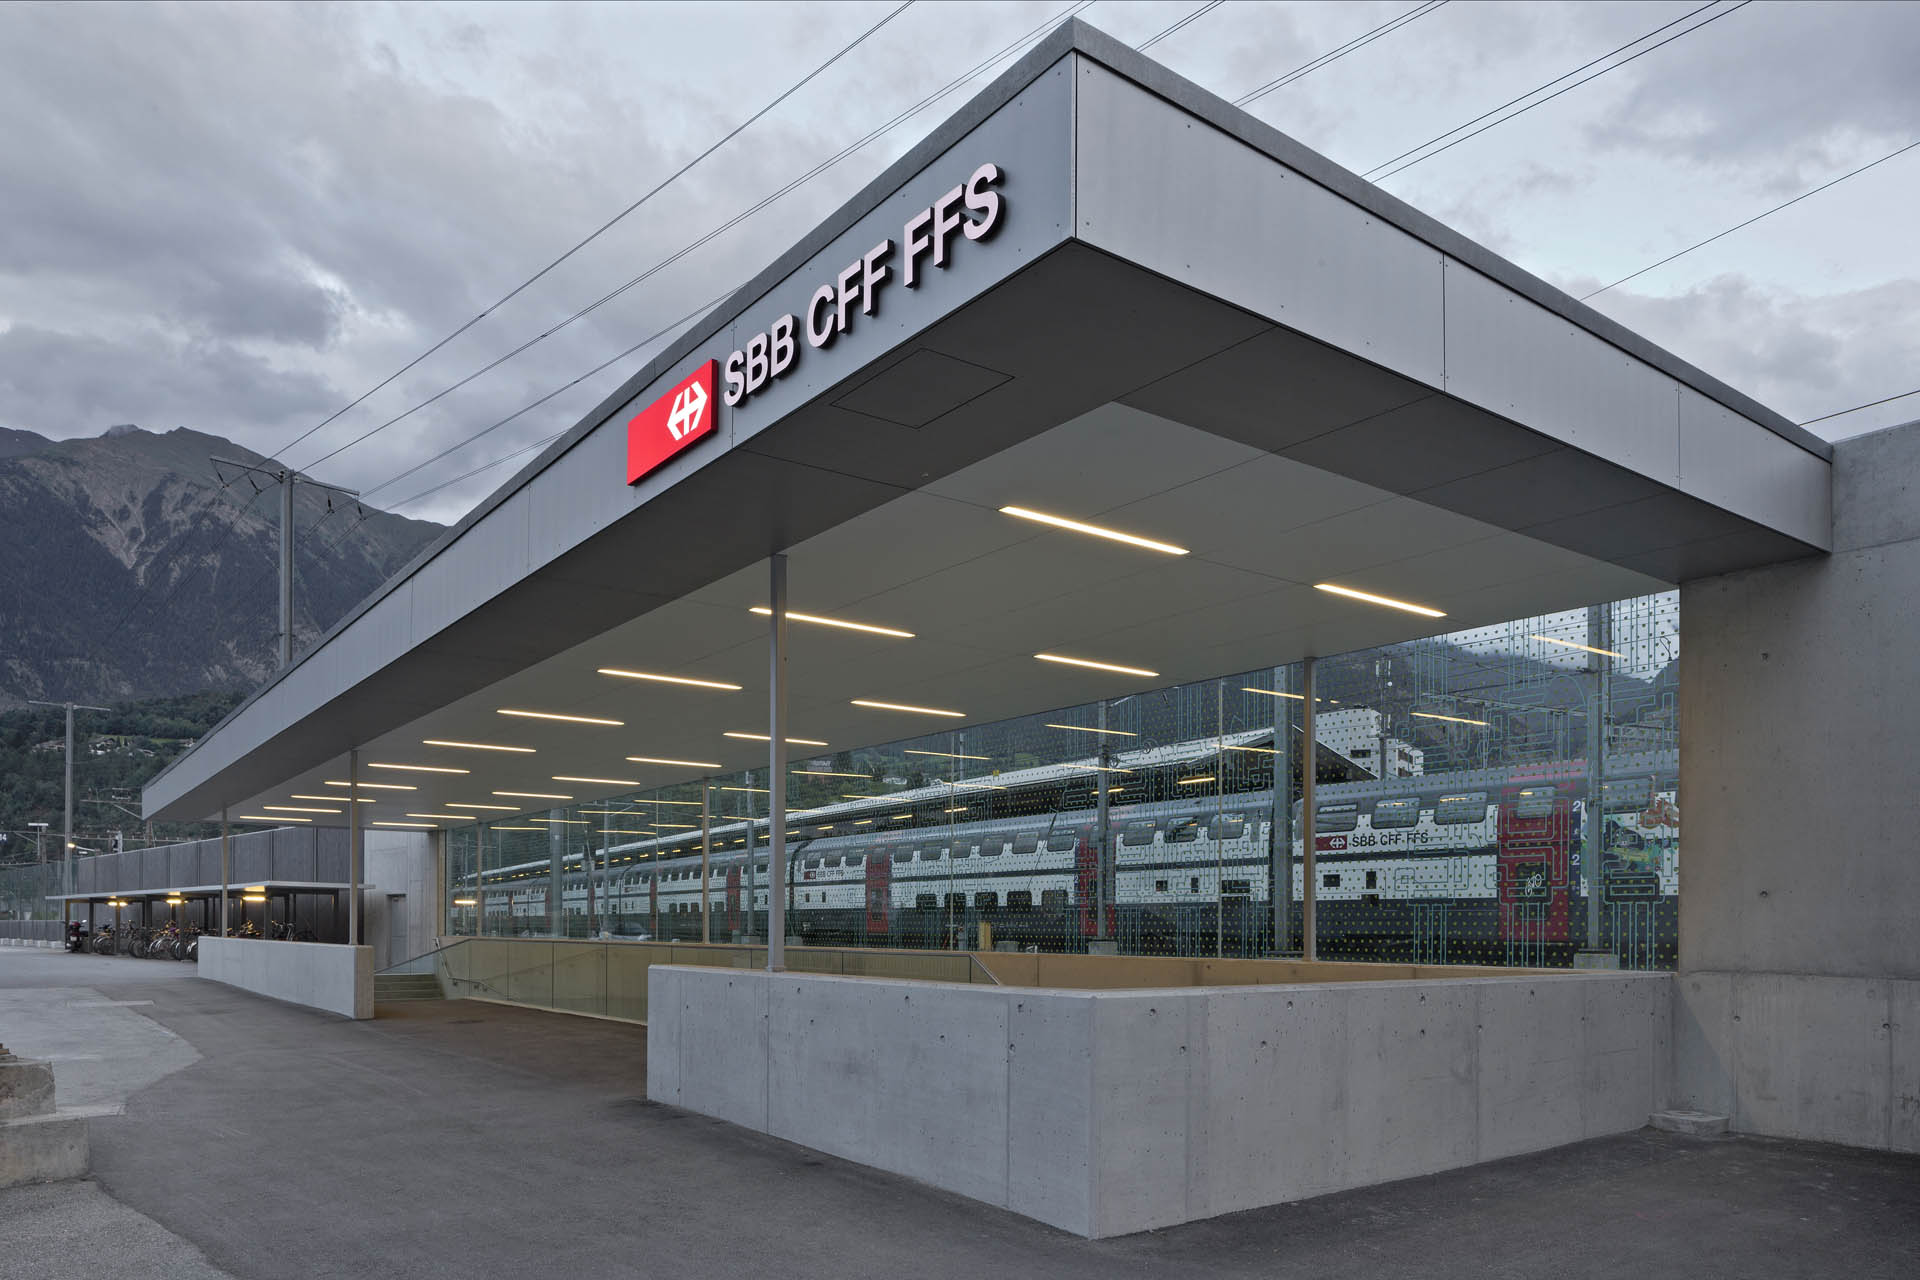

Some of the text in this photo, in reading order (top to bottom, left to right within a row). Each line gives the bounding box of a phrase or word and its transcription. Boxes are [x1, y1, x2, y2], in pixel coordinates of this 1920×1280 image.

[723, 163, 1004, 407] SBB CFF FFS
[1572, 800, 1581, 812] 2
[1352, 832, 1429, 847] SBB CFF FFS
[1571, 854, 1580, 866] 2
